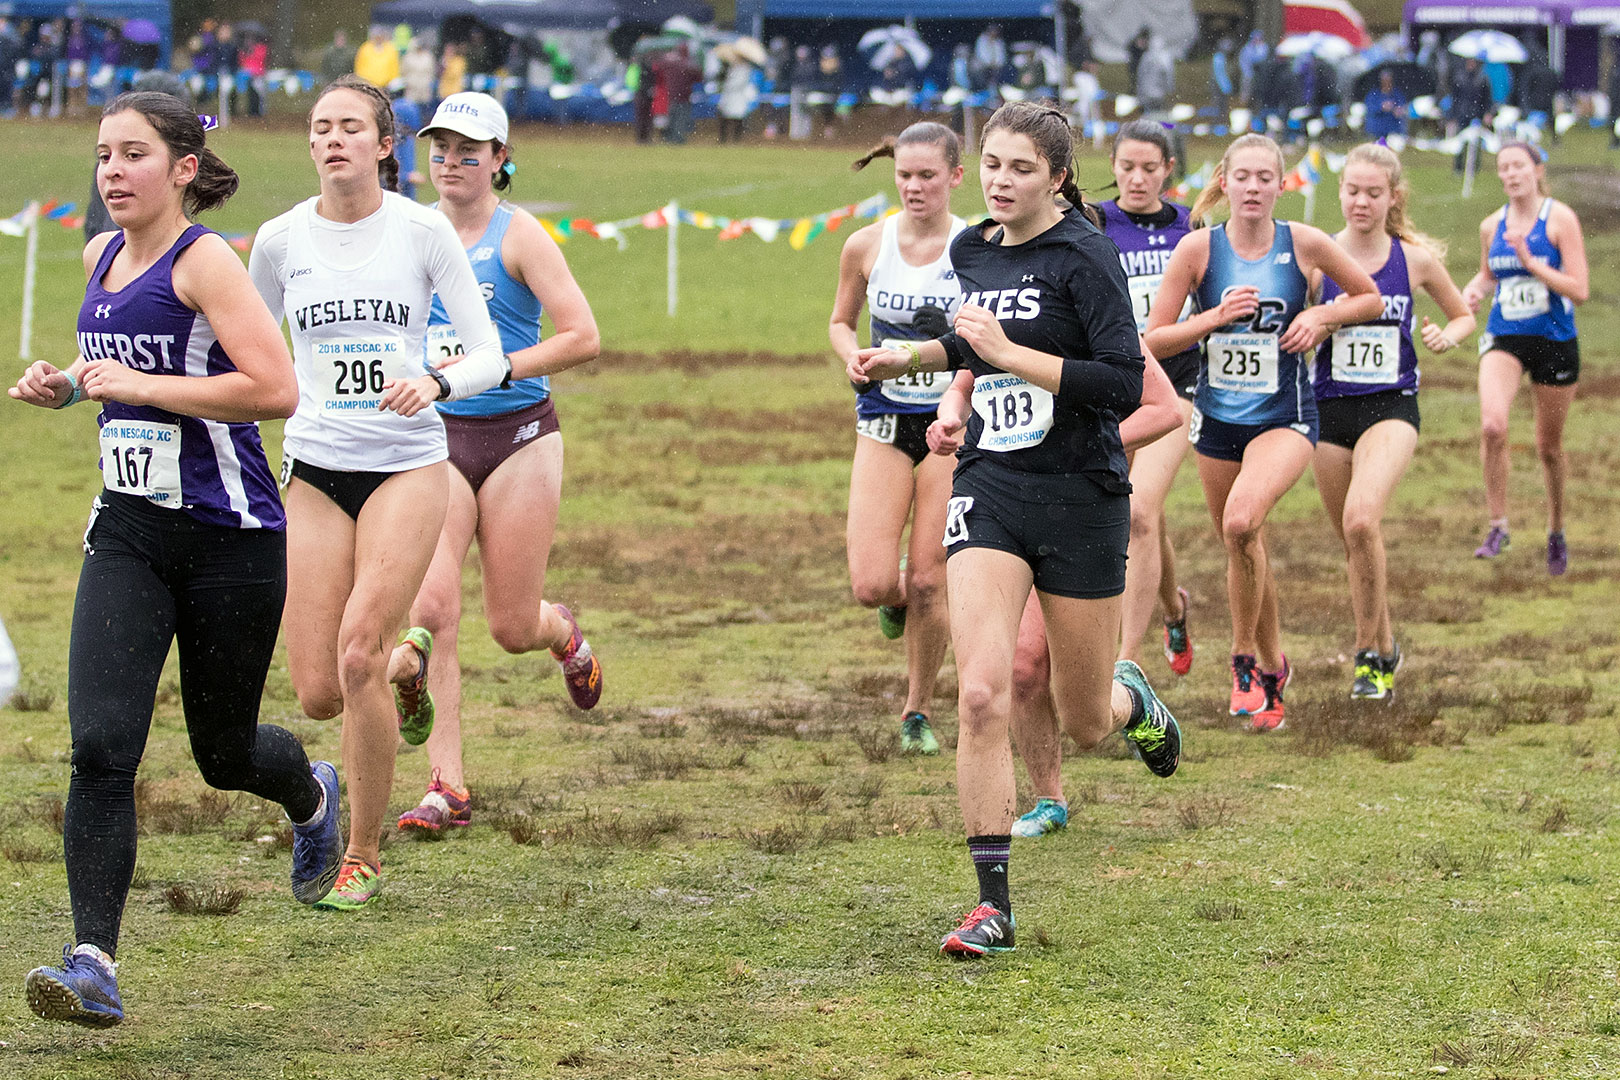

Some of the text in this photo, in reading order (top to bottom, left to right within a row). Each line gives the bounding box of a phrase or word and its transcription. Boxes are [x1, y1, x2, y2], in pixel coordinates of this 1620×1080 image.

[443, 103, 479, 117] Tufts
[296, 267, 312, 276] asics
[295, 299, 410, 332] WESLEYAN
[76, 331, 175, 370] MHERST
[318, 342, 397, 354] 2018 NESCAC XC
[1346, 342, 1383, 368] 176
[1222, 349, 1260, 377] 235
[333, 359, 385, 395] 296
[325, 400, 381, 410] CHAMPIONS
[987, 390, 1034, 433] 183
[102, 427, 172, 442] 2018 NESCAC XC
[112, 446, 154, 489] 167
